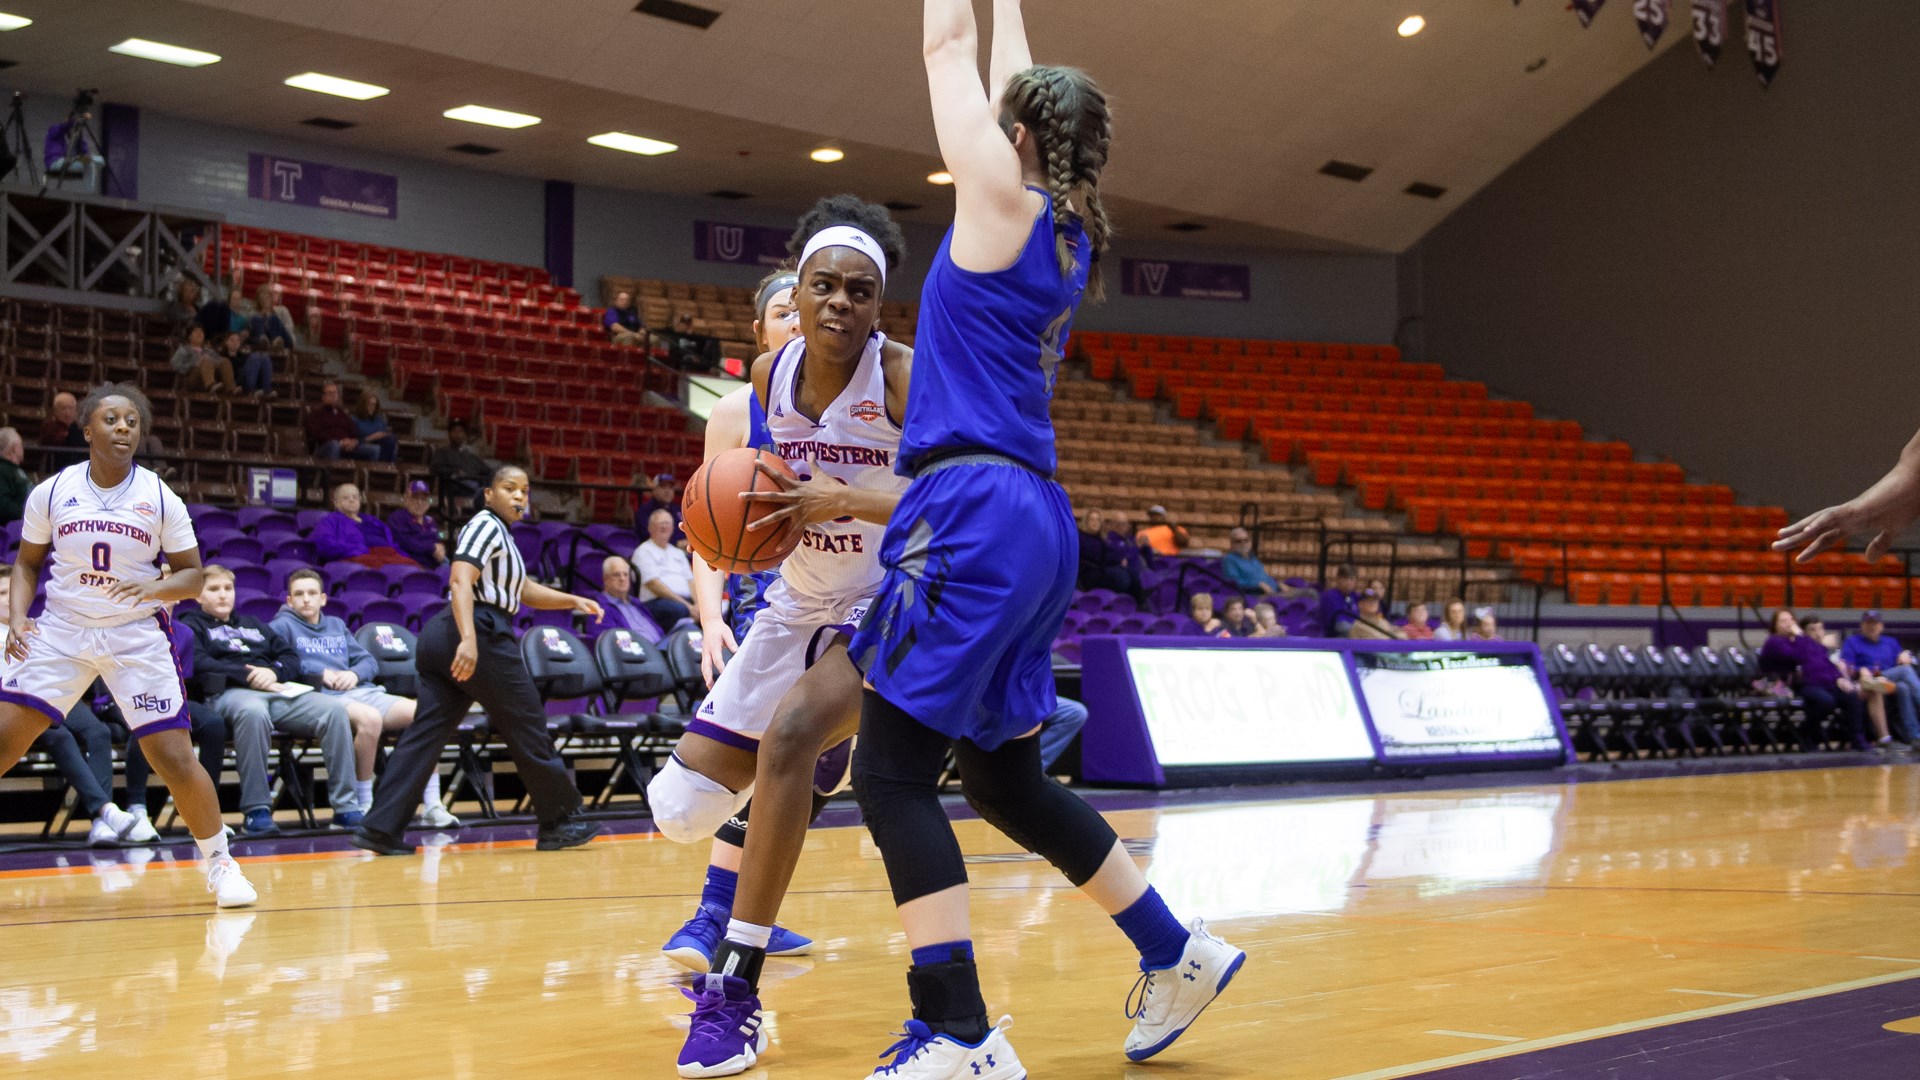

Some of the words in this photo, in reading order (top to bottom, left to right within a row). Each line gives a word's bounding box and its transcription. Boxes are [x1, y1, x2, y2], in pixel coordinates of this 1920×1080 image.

[1691, 9, 1722, 45] 33
[1747, 29, 1778, 66] 45
[274, 160, 302, 201] T
[715, 226, 744, 259] U
[1141, 262, 1169, 294] V
[777, 440, 890, 467] ORTHWESTERN
[250, 468, 270, 504] F
[58, 520, 152, 547] NORTHWESTERN
[802, 528, 863, 554] STATE
[91, 541, 111, 572] 0
[80, 573, 121, 587] STAT
[132, 692, 172, 713] NSU
[1135, 661, 1248, 724] FROG
[1255, 661, 1348, 721] PND
